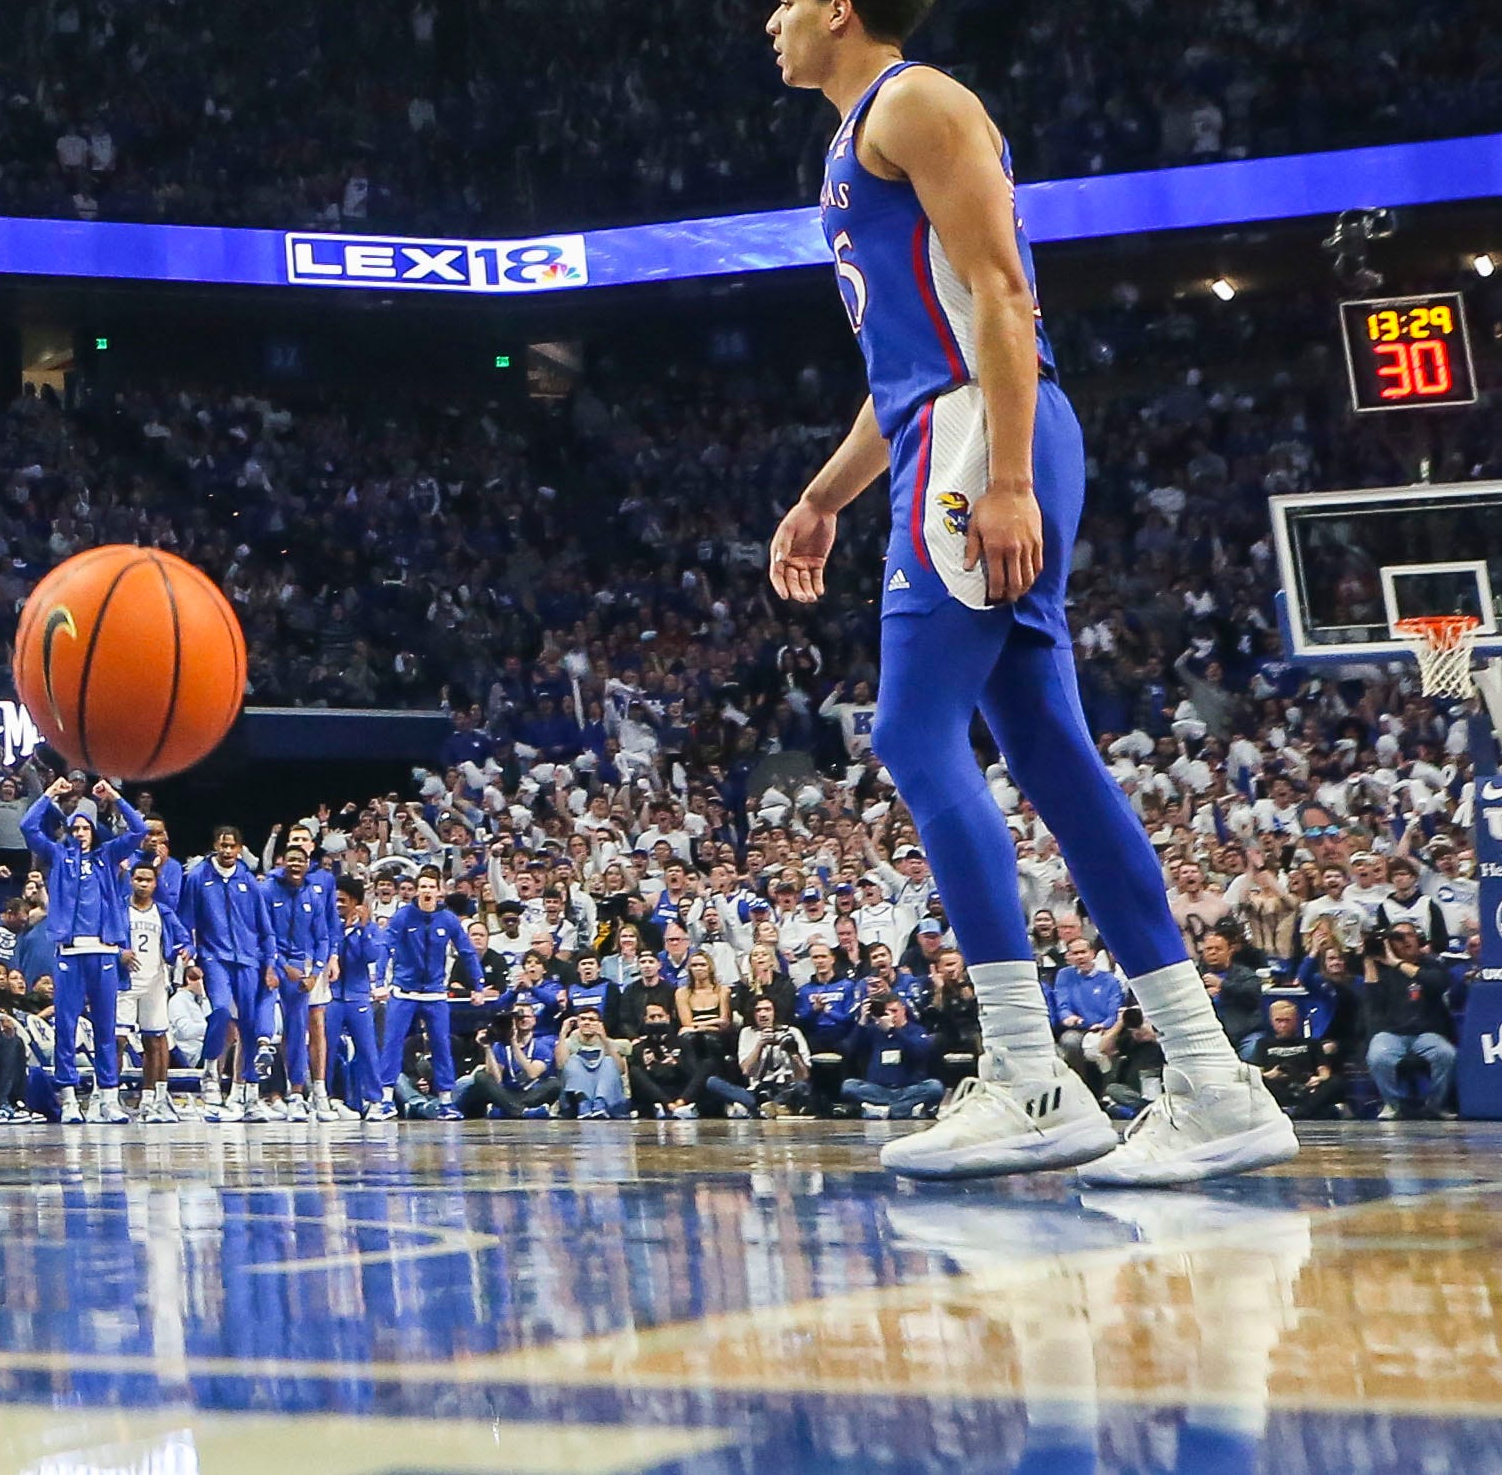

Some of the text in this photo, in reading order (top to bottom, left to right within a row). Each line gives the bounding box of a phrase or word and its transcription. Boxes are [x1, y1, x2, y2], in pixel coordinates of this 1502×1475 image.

[1367, 305, 1454, 342] 13:29
[1373, 338, 1454, 399] 30
[138, 934, 149, 953] 2
